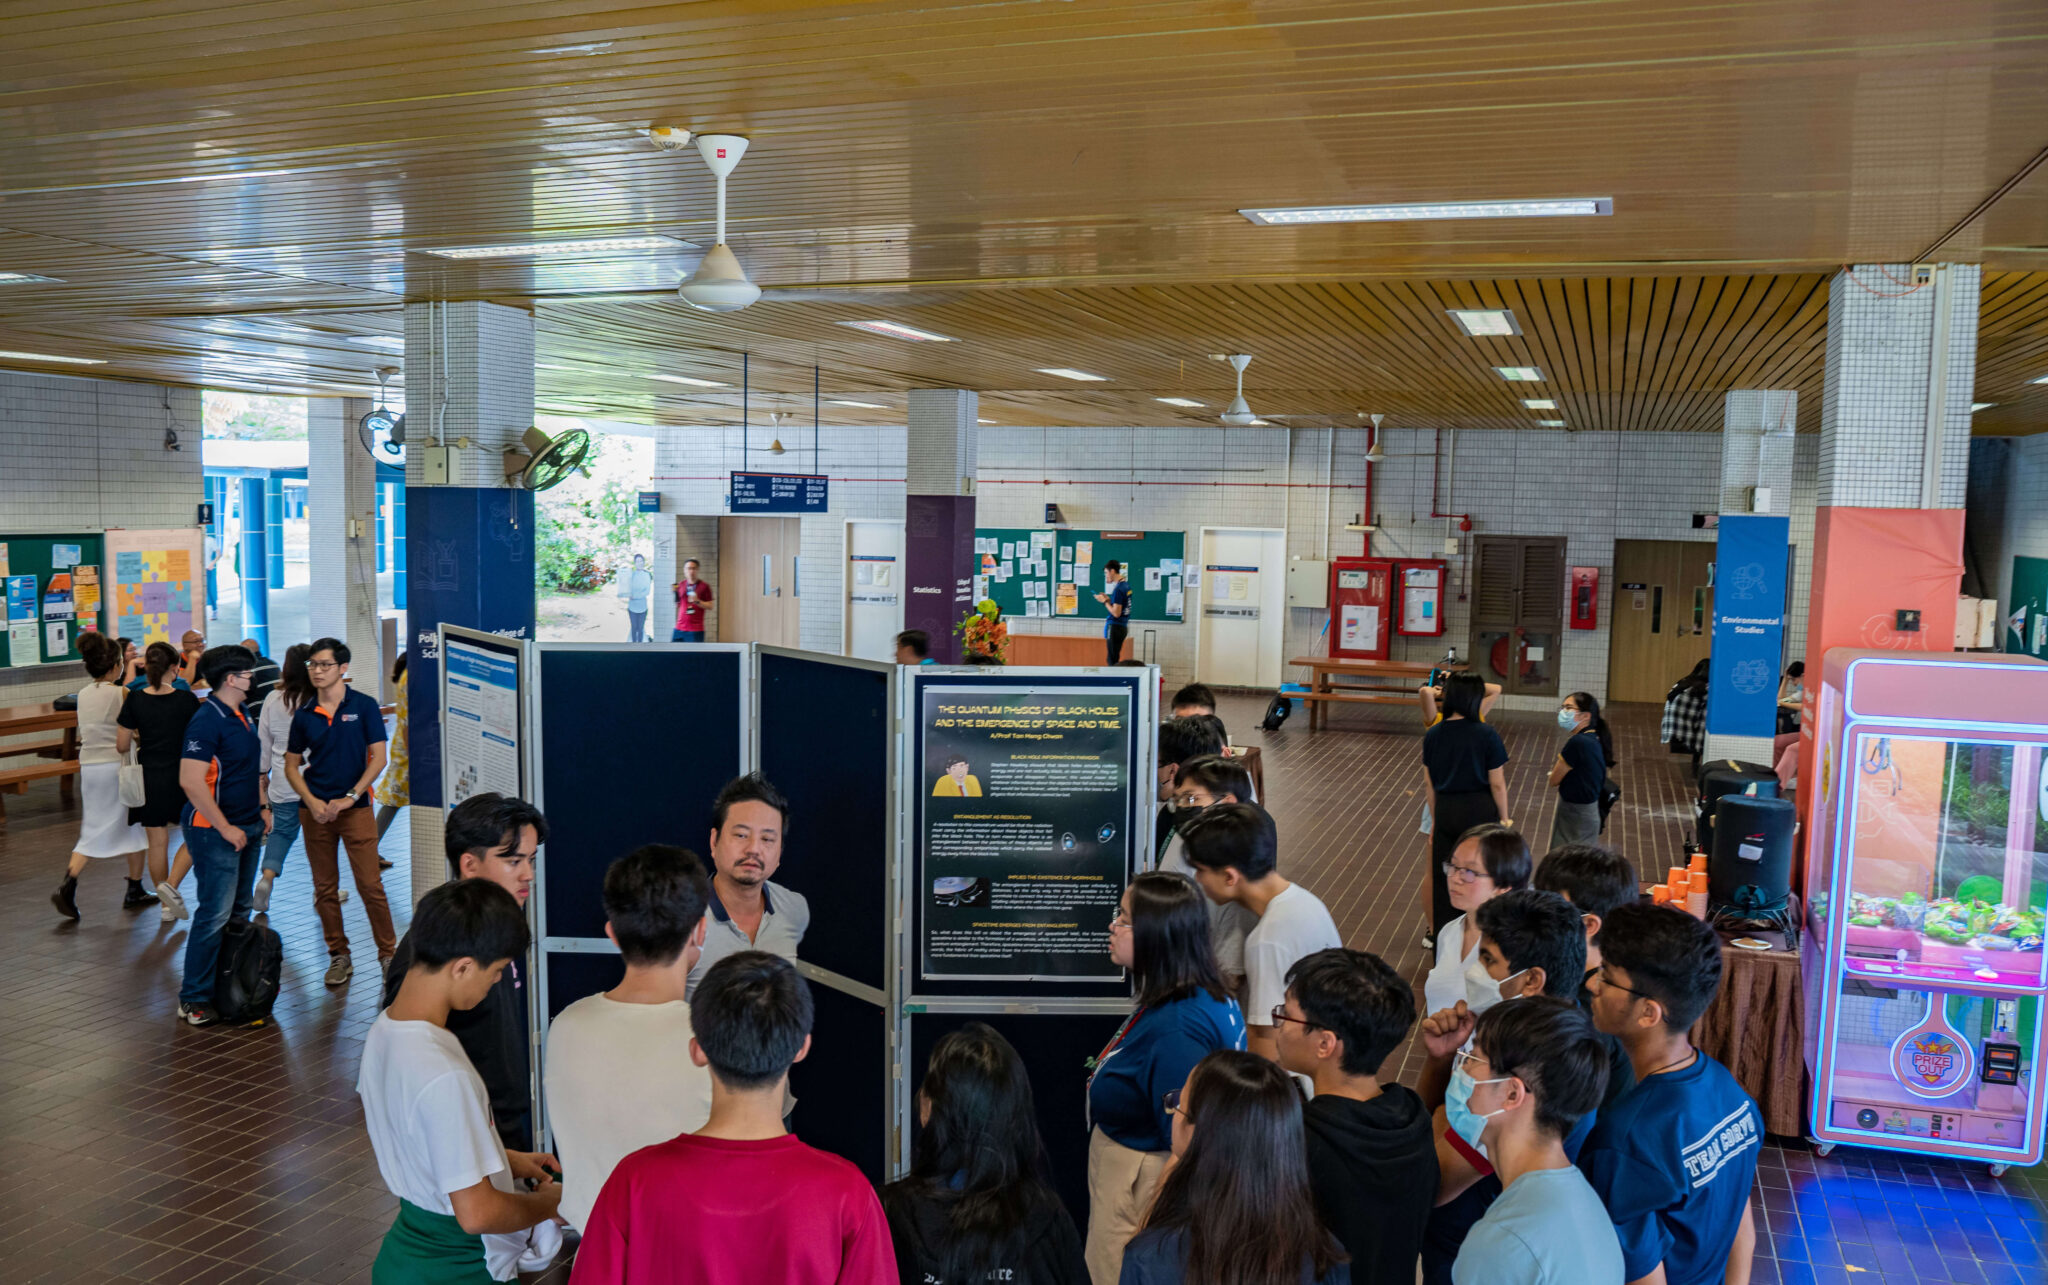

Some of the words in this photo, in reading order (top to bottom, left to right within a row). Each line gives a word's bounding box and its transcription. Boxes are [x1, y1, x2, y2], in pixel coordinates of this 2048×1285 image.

[1722, 616, 1780, 626] Environmental
[517, 626, 526, 636] of
[1734, 626, 1765, 634] Studies
[938, 706, 956, 714] THE
[958, 707, 1002, 715] QUANTUM
[1004, 707, 1040, 715] PHYSICS
[1043, 707, 1055, 715] OF
[1057, 707, 1086, 715] BLACK
[1089, 708, 1119, 716] HOLES
[936, 720, 954, 728] AND
[956, 720, 973, 728] THE
[976, 720, 1030, 728] EMERGENCE
[1032, 720, 1044, 728] OF
[1046, 721, 1076, 729] SPACE
[1078, 721, 1096, 729] AND
[1914, 1054, 1951, 1067] PRIZE
[1918, 1065, 1945, 1075] OUT
